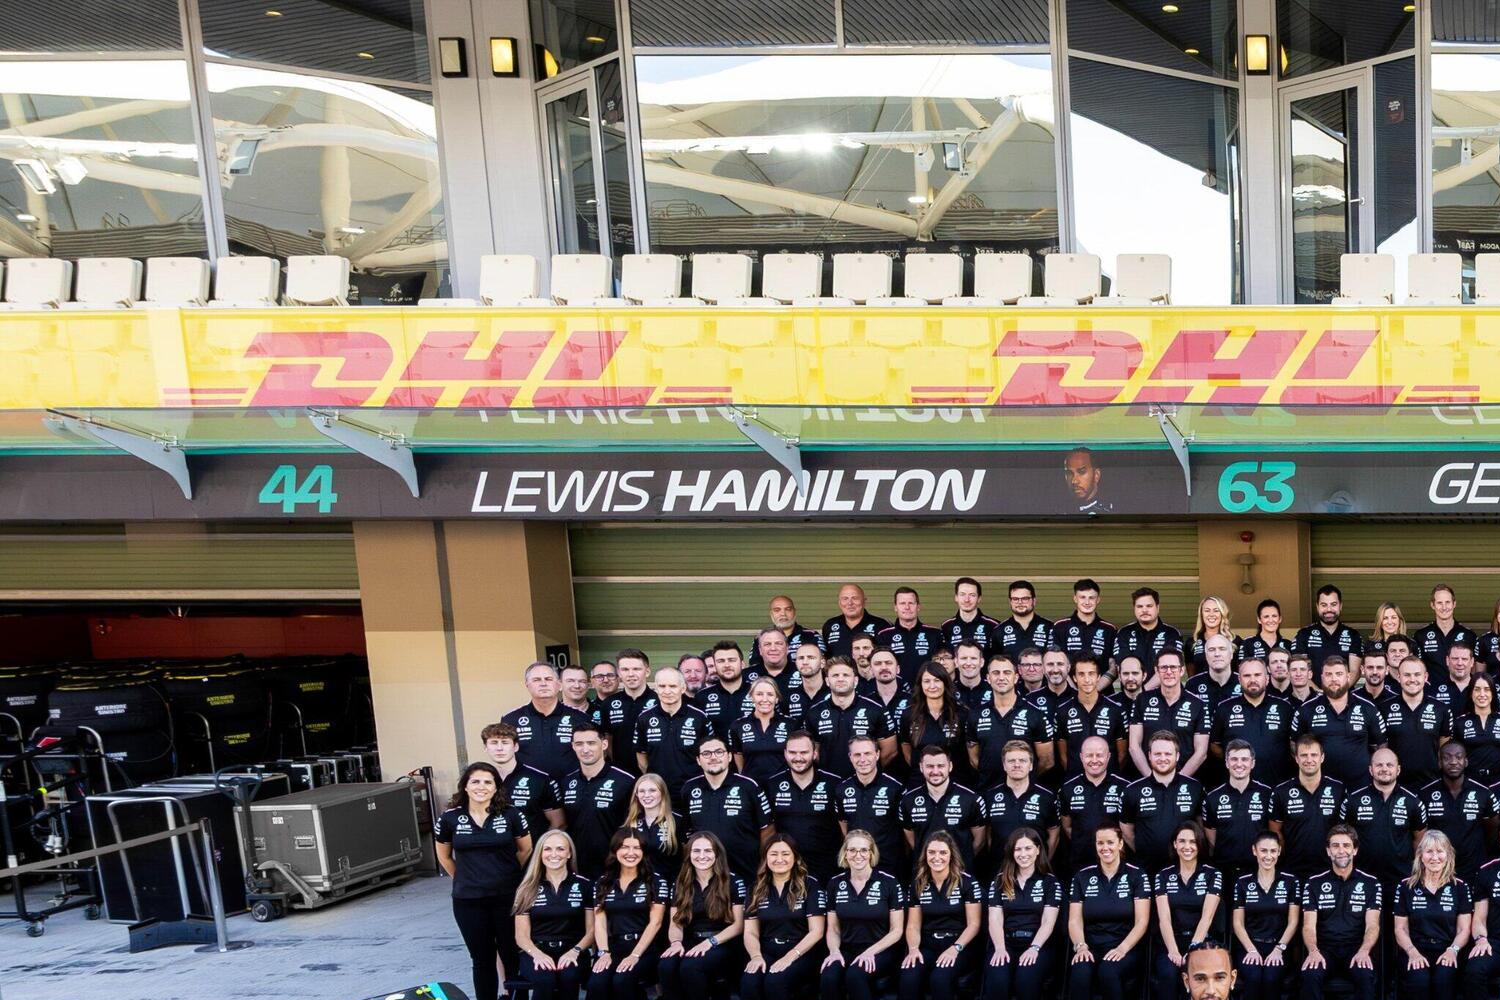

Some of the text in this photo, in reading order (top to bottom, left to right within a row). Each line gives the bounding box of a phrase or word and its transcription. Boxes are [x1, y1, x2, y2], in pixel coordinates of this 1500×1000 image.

[236, 331, 657, 412] DHL
[990, 330, 1403, 412] DHL
[258, 464, 338, 513] 44
[470, 469, 987, 513] LEWIS HAMILTON
[1217, 461, 1296, 512] 63
[550, 652, 568, 670] 10
